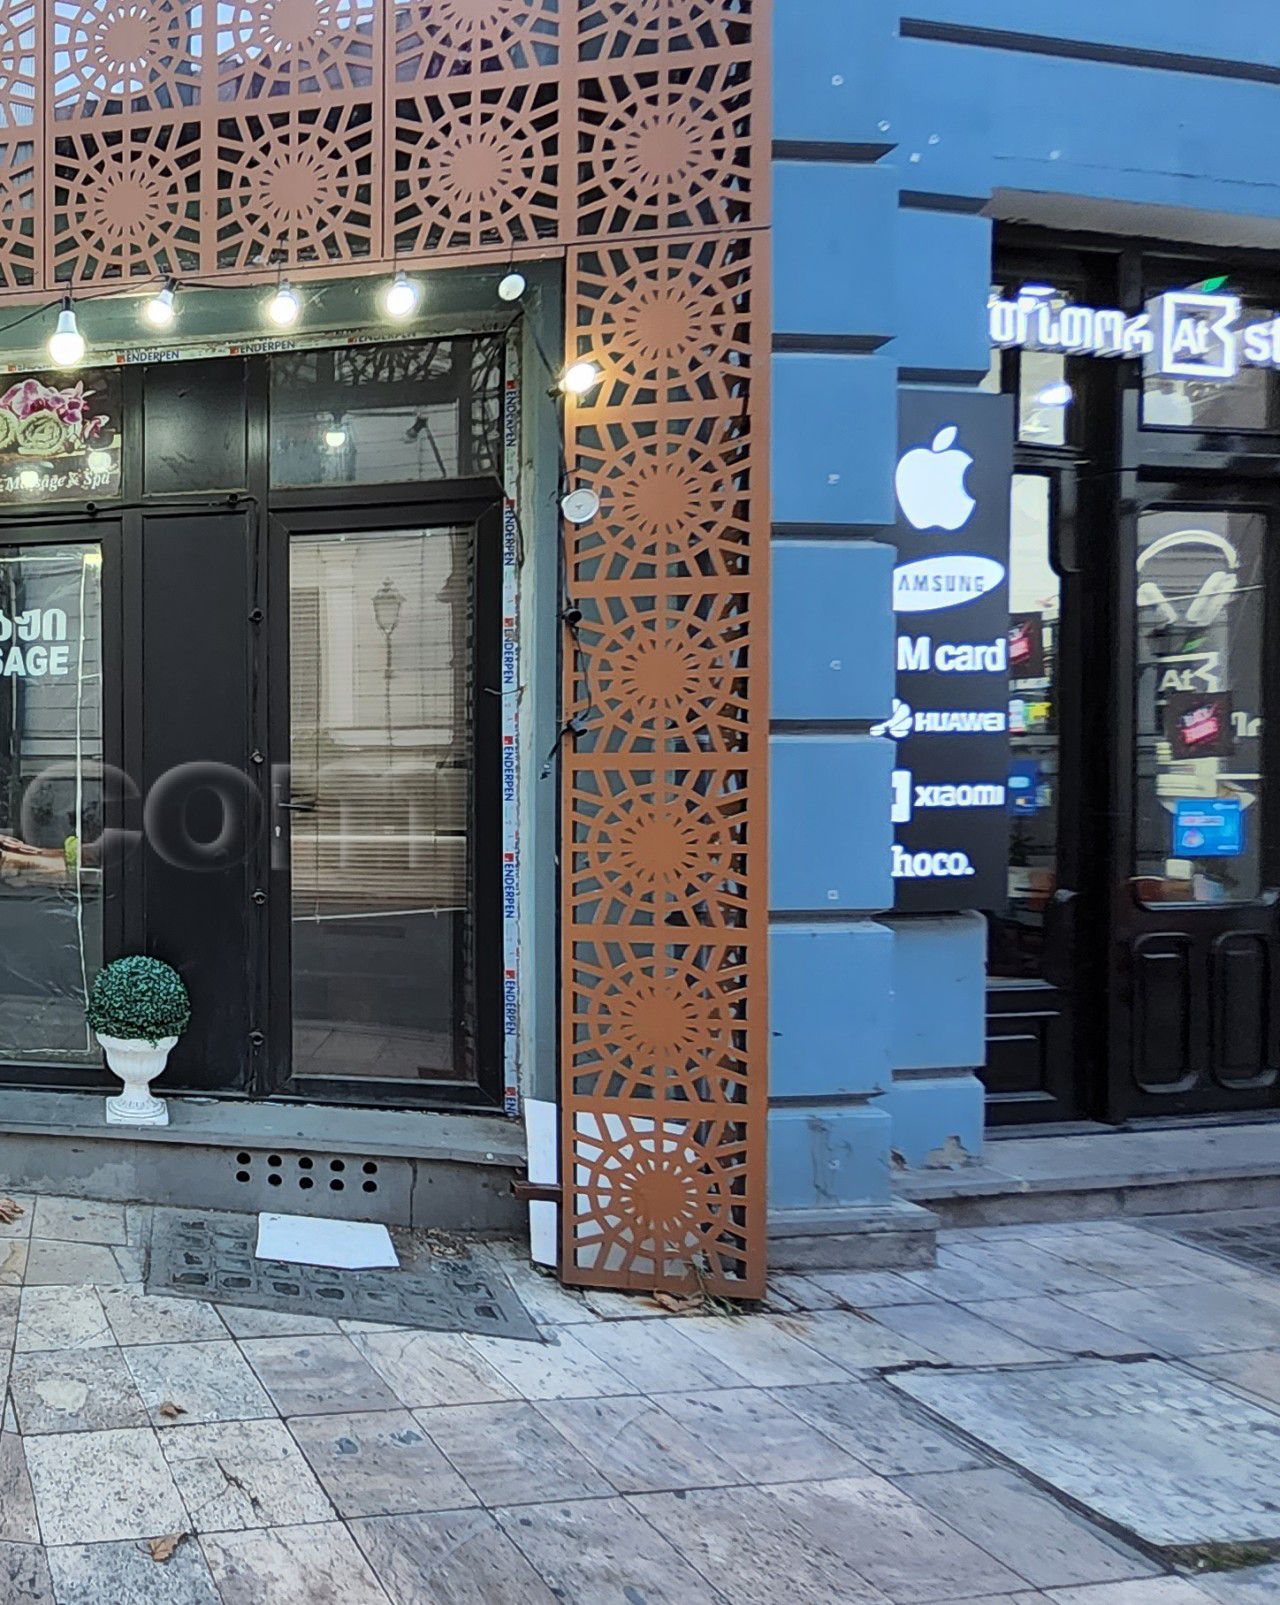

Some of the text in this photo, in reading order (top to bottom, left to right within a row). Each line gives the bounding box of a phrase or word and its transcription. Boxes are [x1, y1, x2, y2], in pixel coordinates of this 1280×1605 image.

[125, 350, 180, 363] ENDERPEN
[240, 340, 296, 355] ENDERPEN
[505, 390, 517, 448] ENDERPEN
[6, 474, 64, 493] Msage
[504, 507, 515, 566] ENDERPEN
[897, 573, 985, 593] AMSUNG
[934, 637, 1008, 673] card
[914, 711, 1006, 732] HUAWEI
[504, 746, 515, 801] ENDERPEN
[913, 784, 1006, 808] xiaomi
[890, 844, 976, 878] hoco.
[504, 863, 515, 919] ENDERPEN
[505, 980, 516, 1036] ENDERPEN
